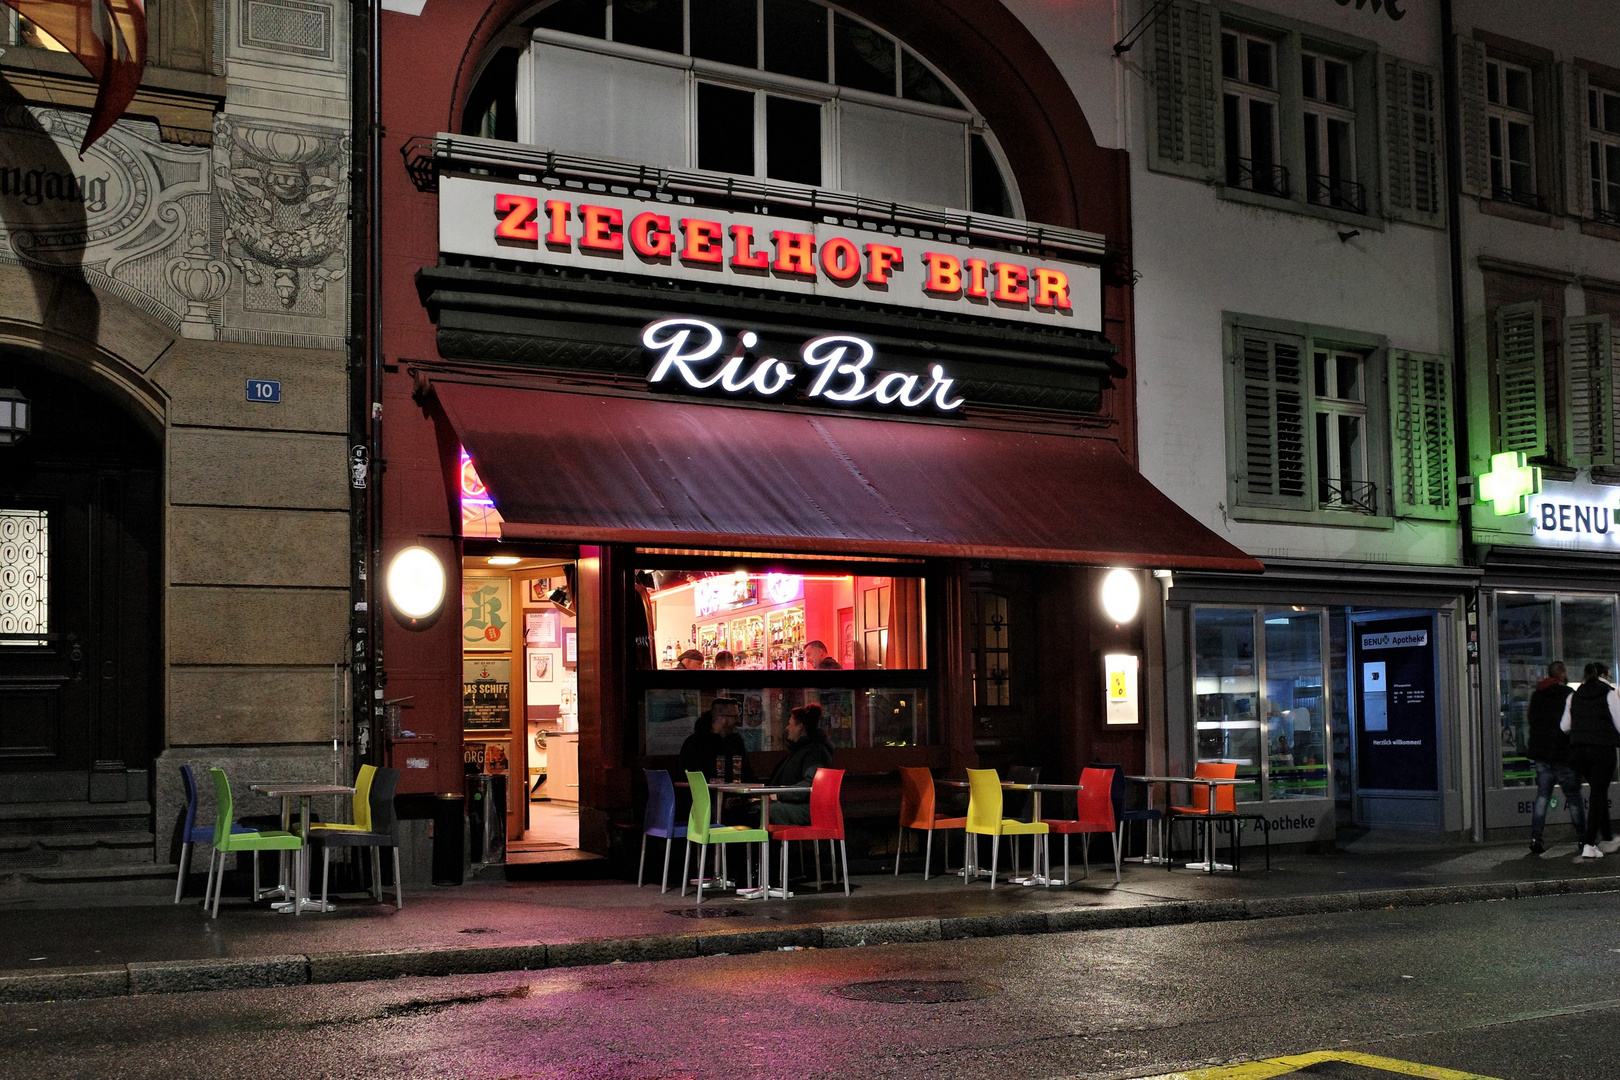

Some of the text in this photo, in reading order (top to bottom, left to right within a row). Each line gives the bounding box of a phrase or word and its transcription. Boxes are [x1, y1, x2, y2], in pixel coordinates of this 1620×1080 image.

[494, 193, 1073, 310] ZIEGELHOF BIER
[641, 317, 966, 412] Rio Bar
[256, 383, 273, 398] 10
[1541, 503, 1609, 534] BENU
[1363, 634, 1425, 647] BENU Apotheke
[479, 684, 509, 694] SCHIFF
[1253, 814, 1316, 834] Apotheke
